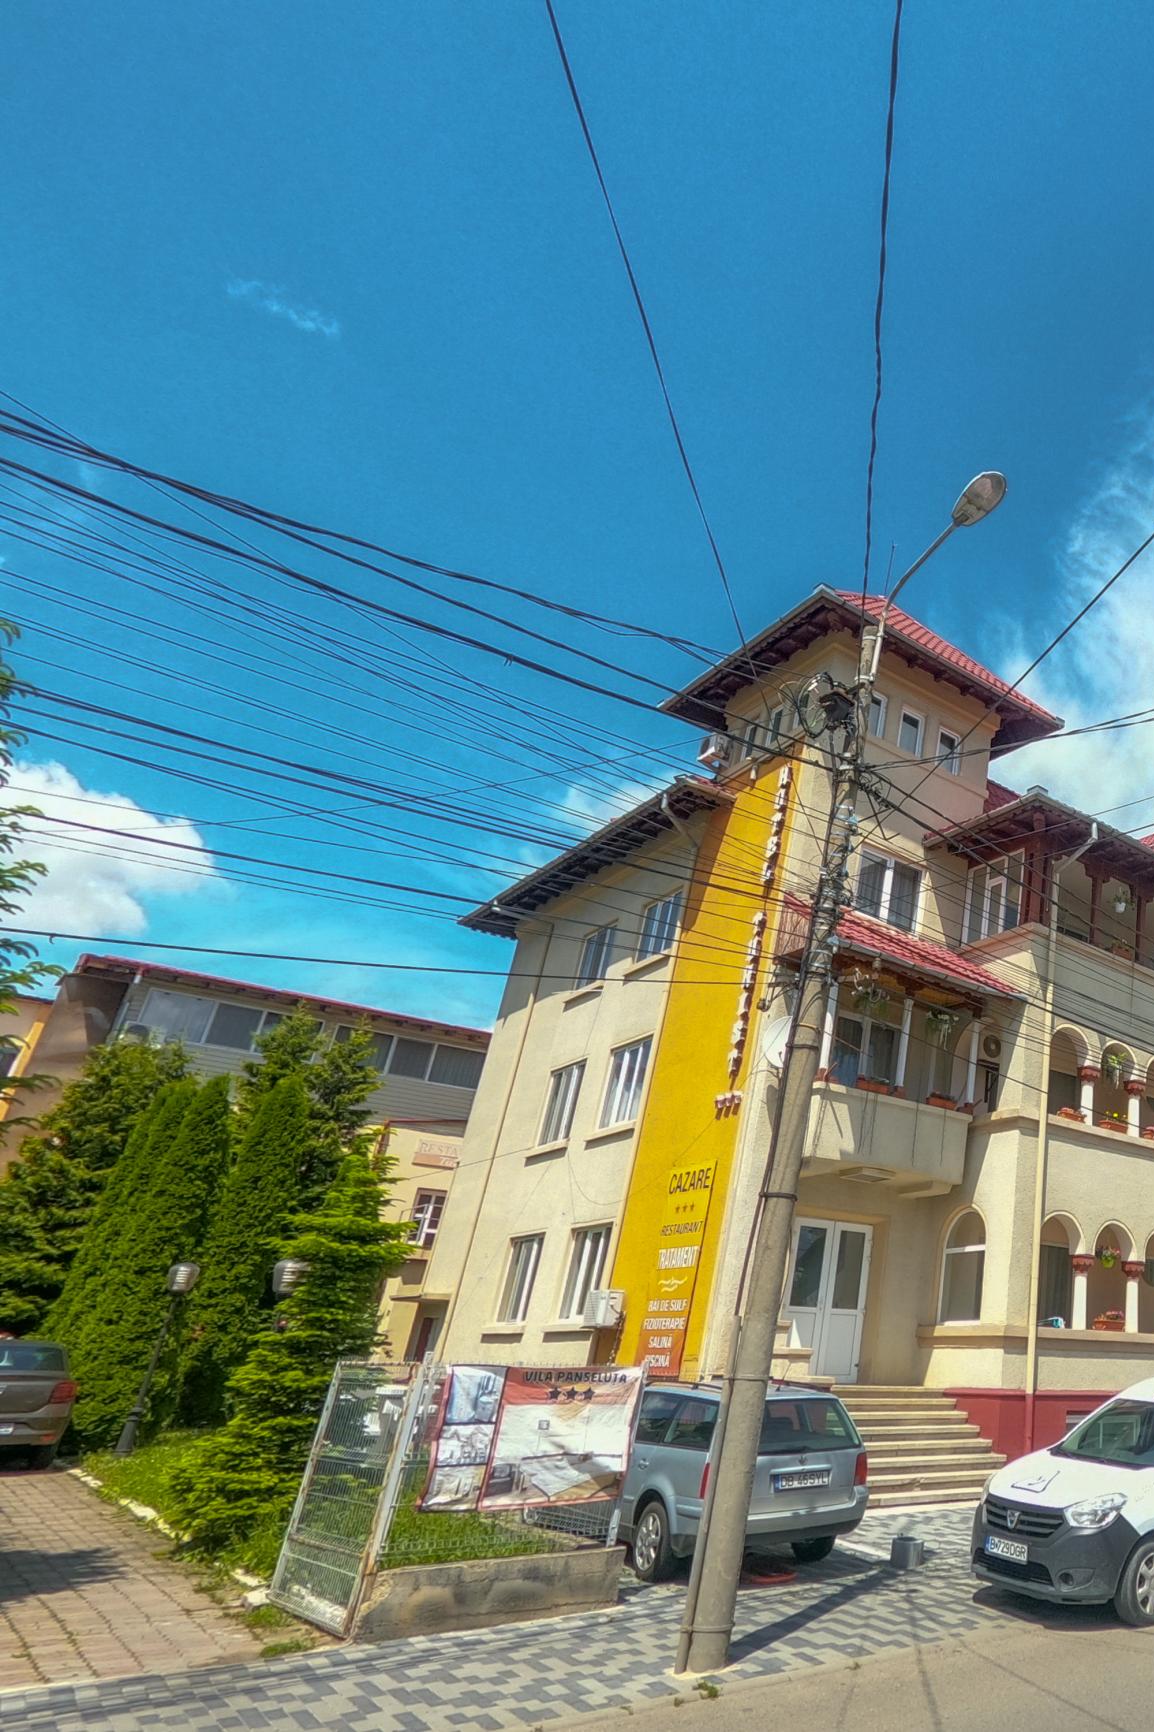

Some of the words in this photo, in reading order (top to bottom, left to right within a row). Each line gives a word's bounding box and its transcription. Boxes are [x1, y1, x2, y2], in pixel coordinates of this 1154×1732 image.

[668, 1168, 711, 1195] CAZARE
[661, 1221, 704, 1236] RESTAURANT
[658, 1246, 698, 1269] TRATAMENT
[643, 1317, 687, 1330] FIZIOTERAPIE
[525, 1371, 553, 1383] VILA
[780, 1476, 794, 1488] DB
